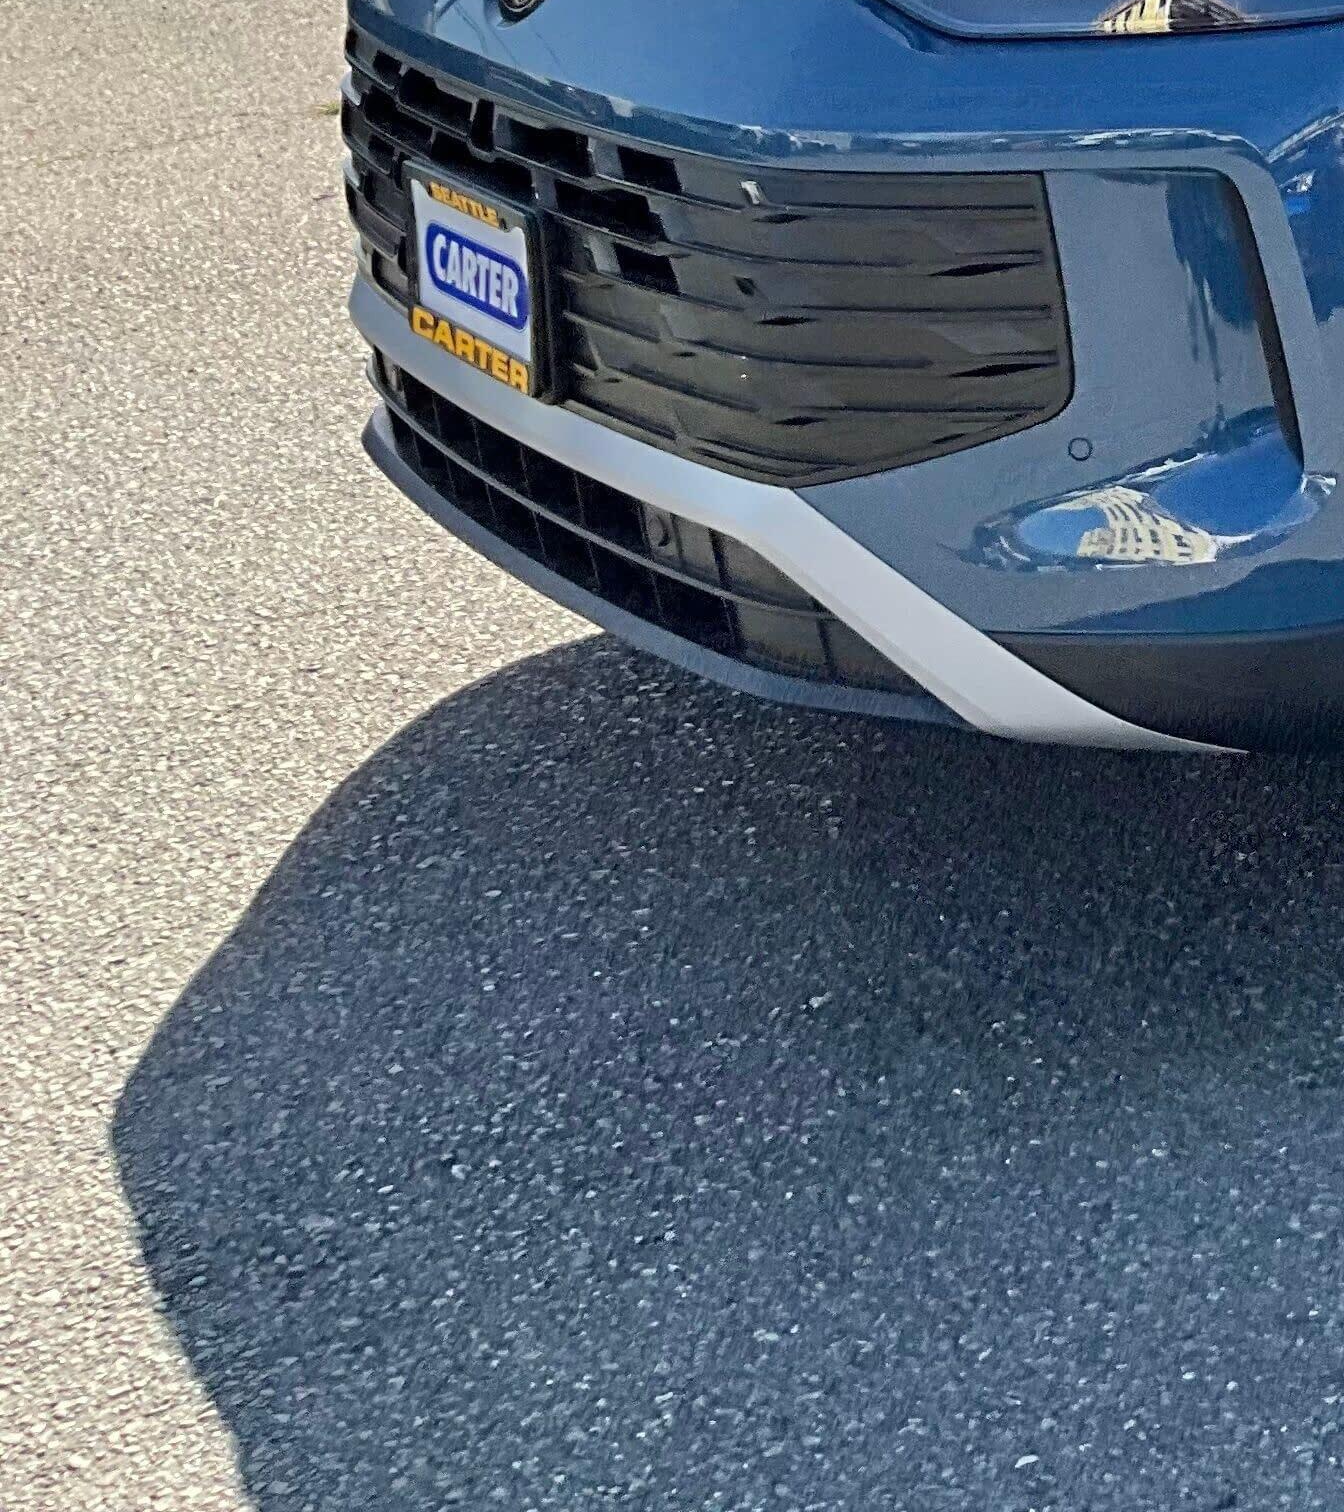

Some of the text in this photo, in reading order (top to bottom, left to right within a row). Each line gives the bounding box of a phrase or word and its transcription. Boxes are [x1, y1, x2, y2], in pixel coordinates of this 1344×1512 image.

[430, 181, 500, 229] SEATTLE
[432, 233, 520, 318] CARTER
[412, 305, 529, 395] CARTER
